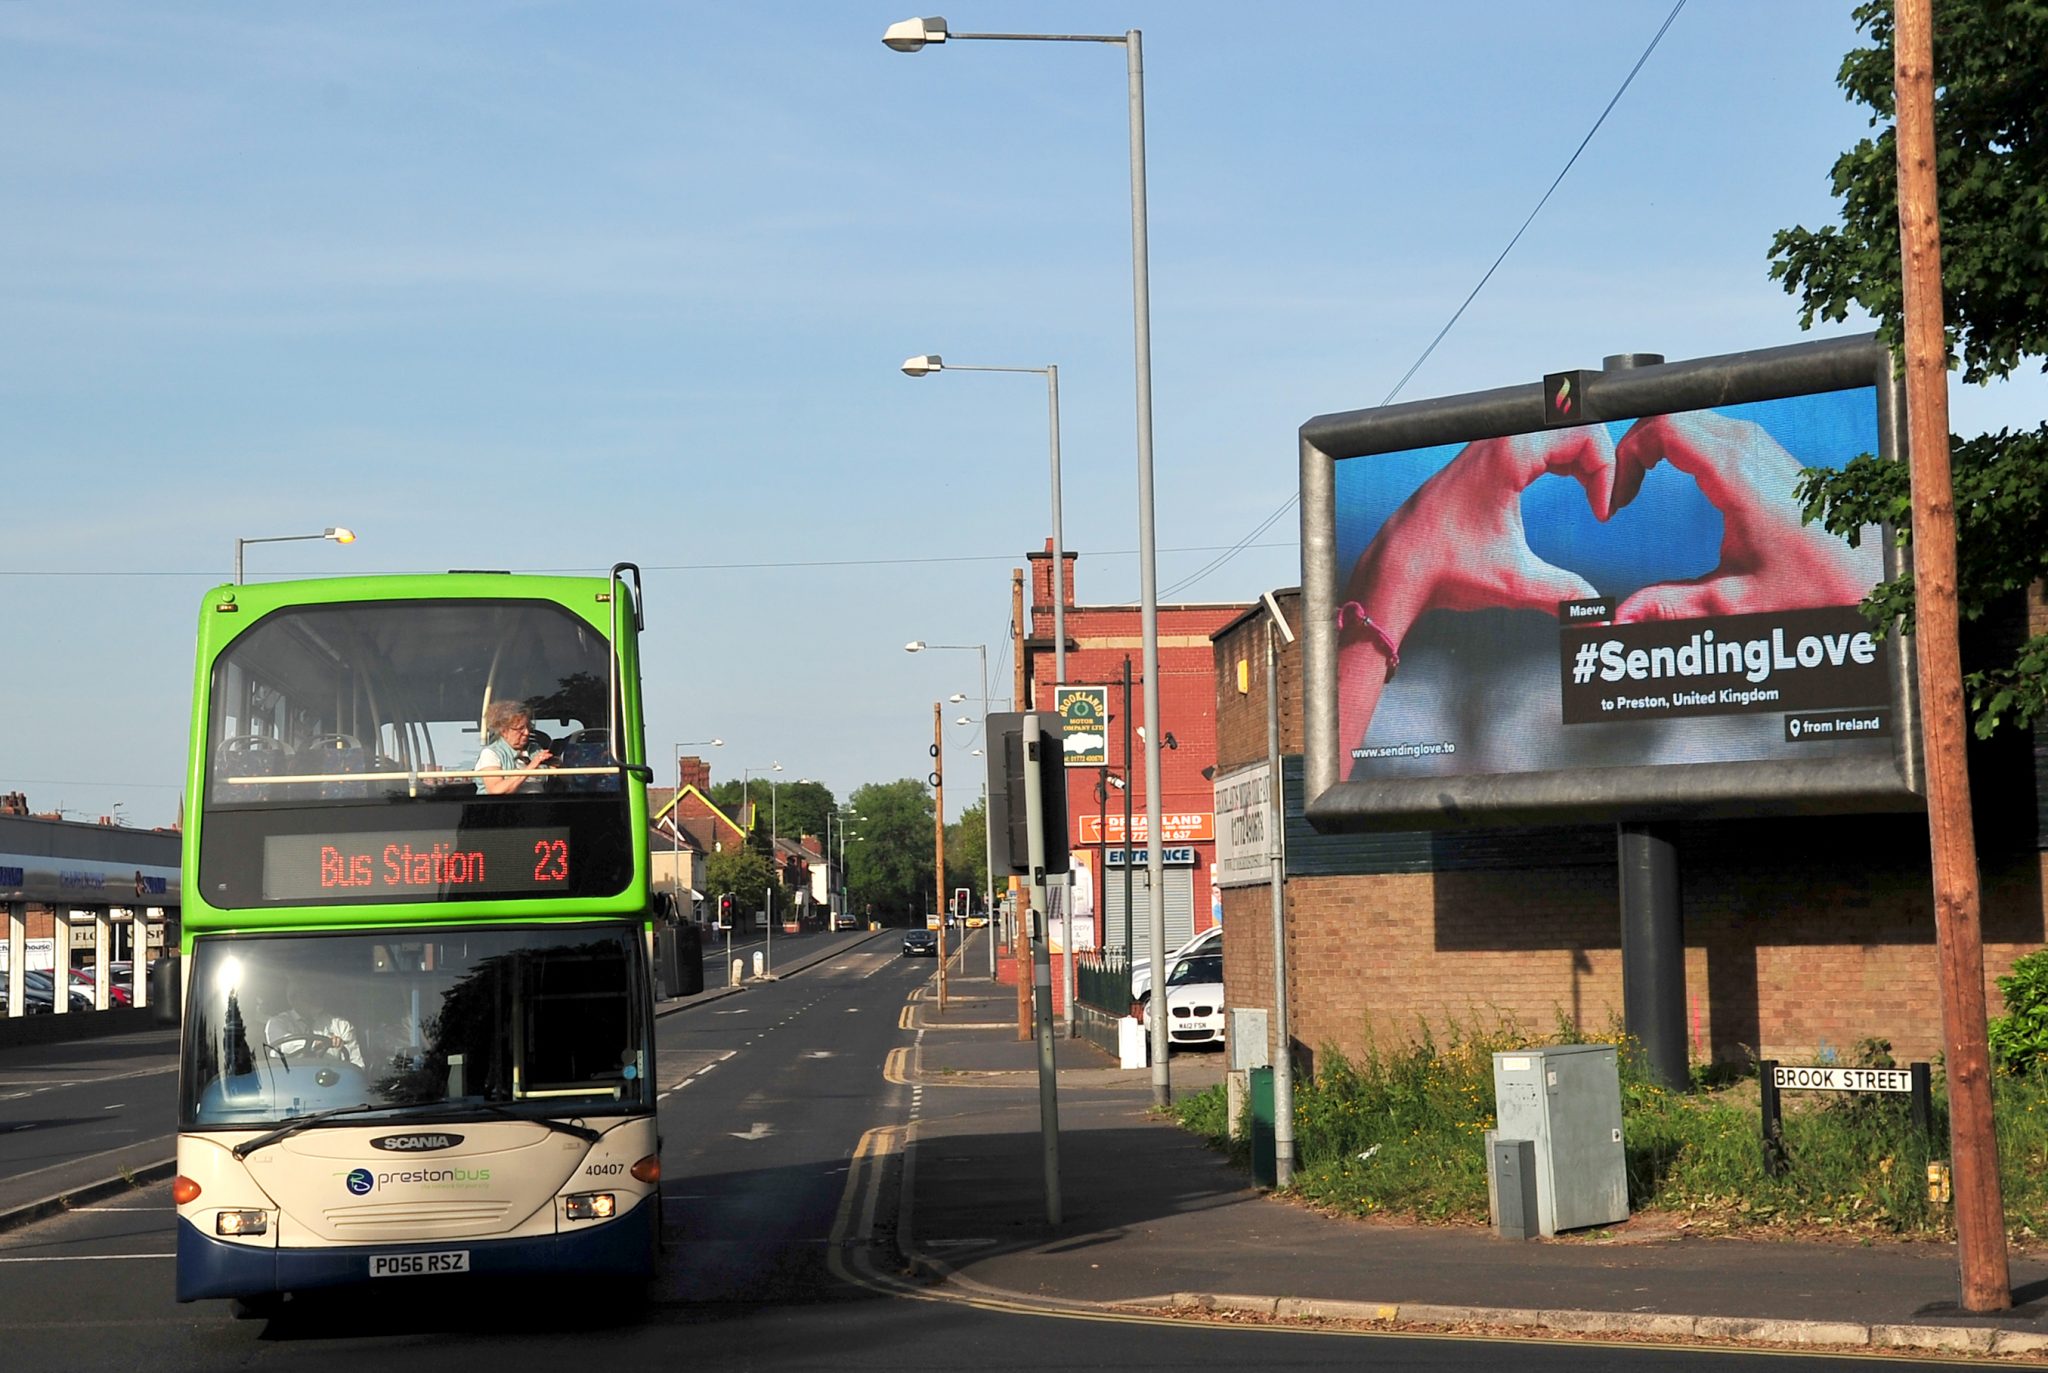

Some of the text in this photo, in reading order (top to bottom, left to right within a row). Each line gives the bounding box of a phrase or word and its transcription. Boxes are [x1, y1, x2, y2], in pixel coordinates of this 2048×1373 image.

[1569, 603, 1606, 617] Maeve
[1573, 627, 1876, 684] #SendingLove
[1059, 691, 1104, 717] BROOKLANDS
[1601, 687, 1779, 711] to Preston, United Kingdom
[1803, 717, 1879, 733] from Ireland
[1352, 742, 1455, 758] www.sendinglove.to
[1109, 815, 1202, 826] DEALAND
[321, 839, 568, 888] Bus Station 23
[1109, 849, 1190, 862] ENTRNCE
[1776, 1069, 1909, 1089] BROOK STREET
[384, 1135, 450, 1150] SCANIA
[585, 1164, 624, 1176] 40407
[378, 1167, 490, 1191] prestonbus
[376, 1254, 463, 1273] PO56 RSZ
